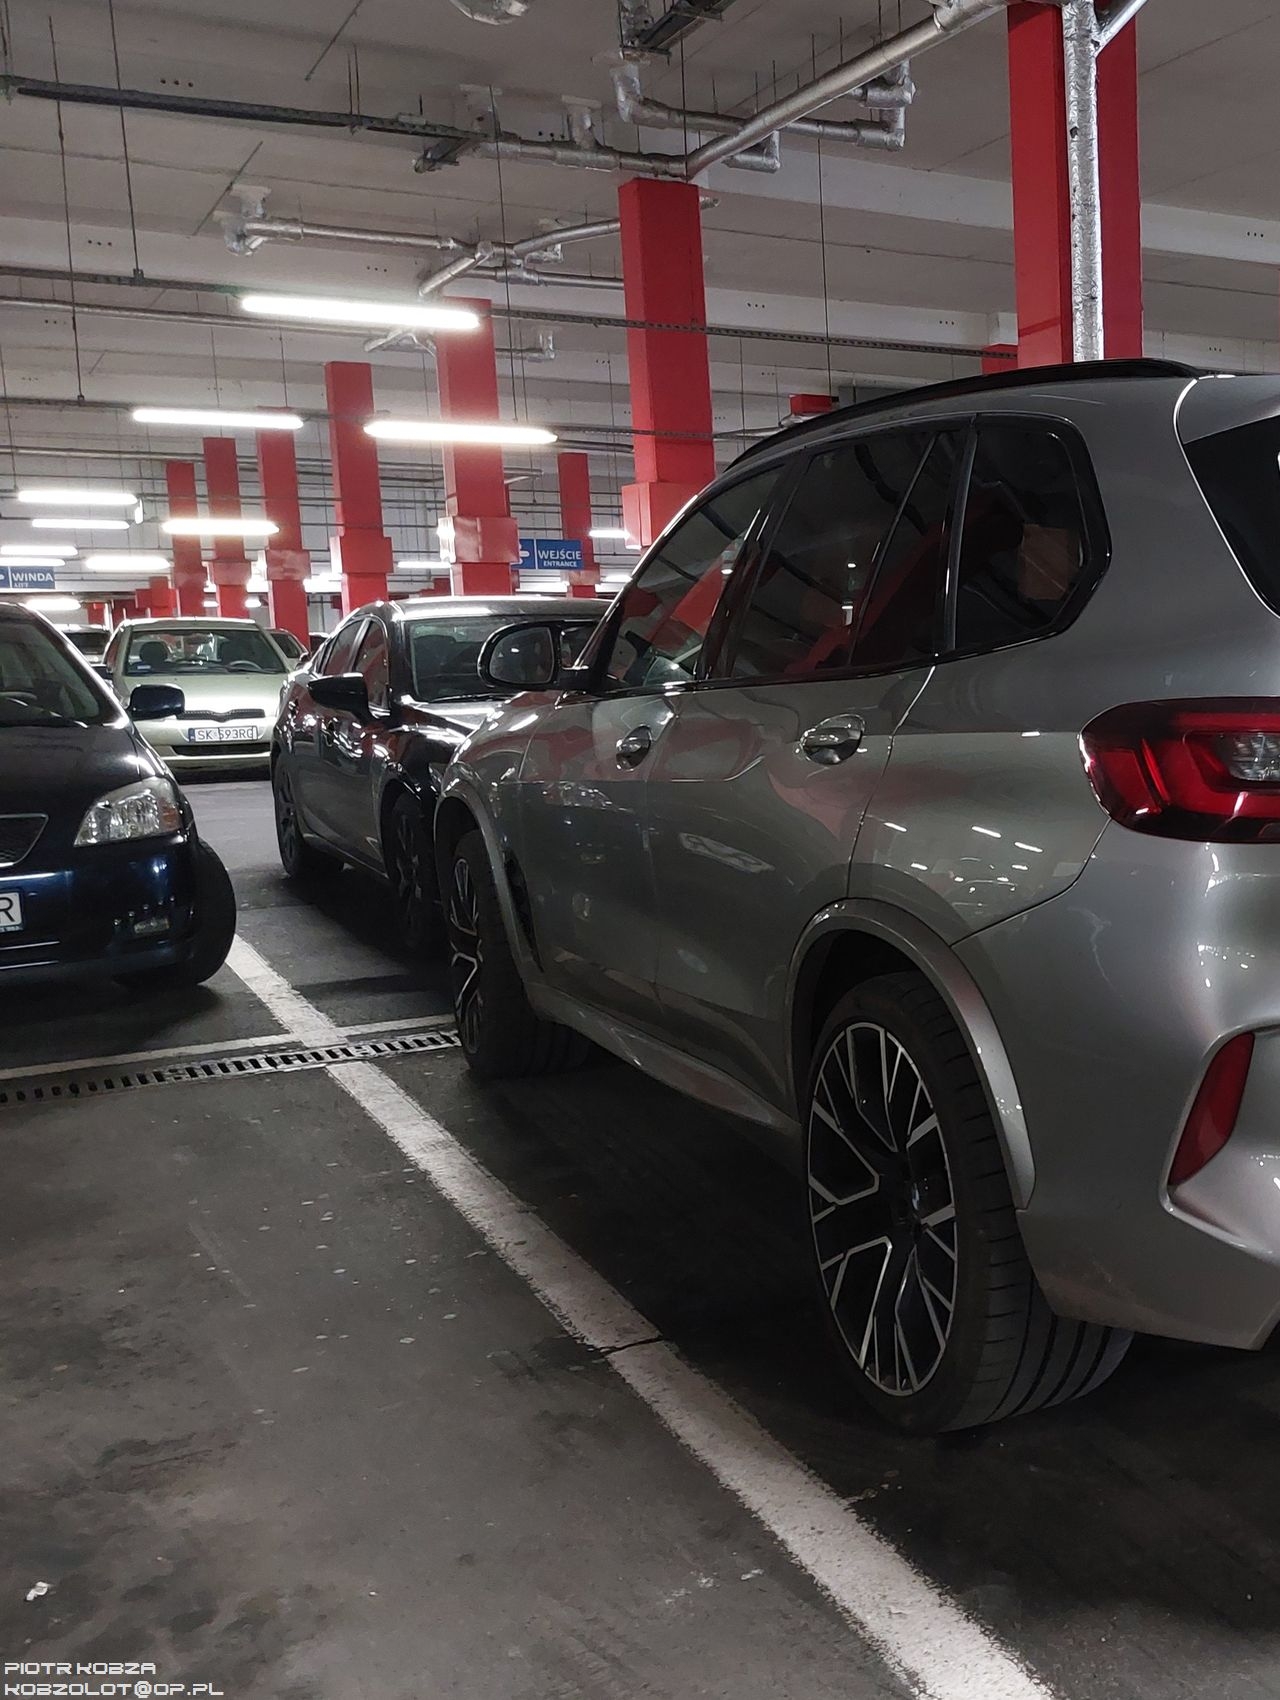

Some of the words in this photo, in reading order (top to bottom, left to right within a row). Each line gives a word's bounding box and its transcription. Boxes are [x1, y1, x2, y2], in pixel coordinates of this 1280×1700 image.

[538, 548, 582, 560] WEJŚCIE
[12, 572, 54, 582] WINDA
[198, 729, 213, 740] SK
